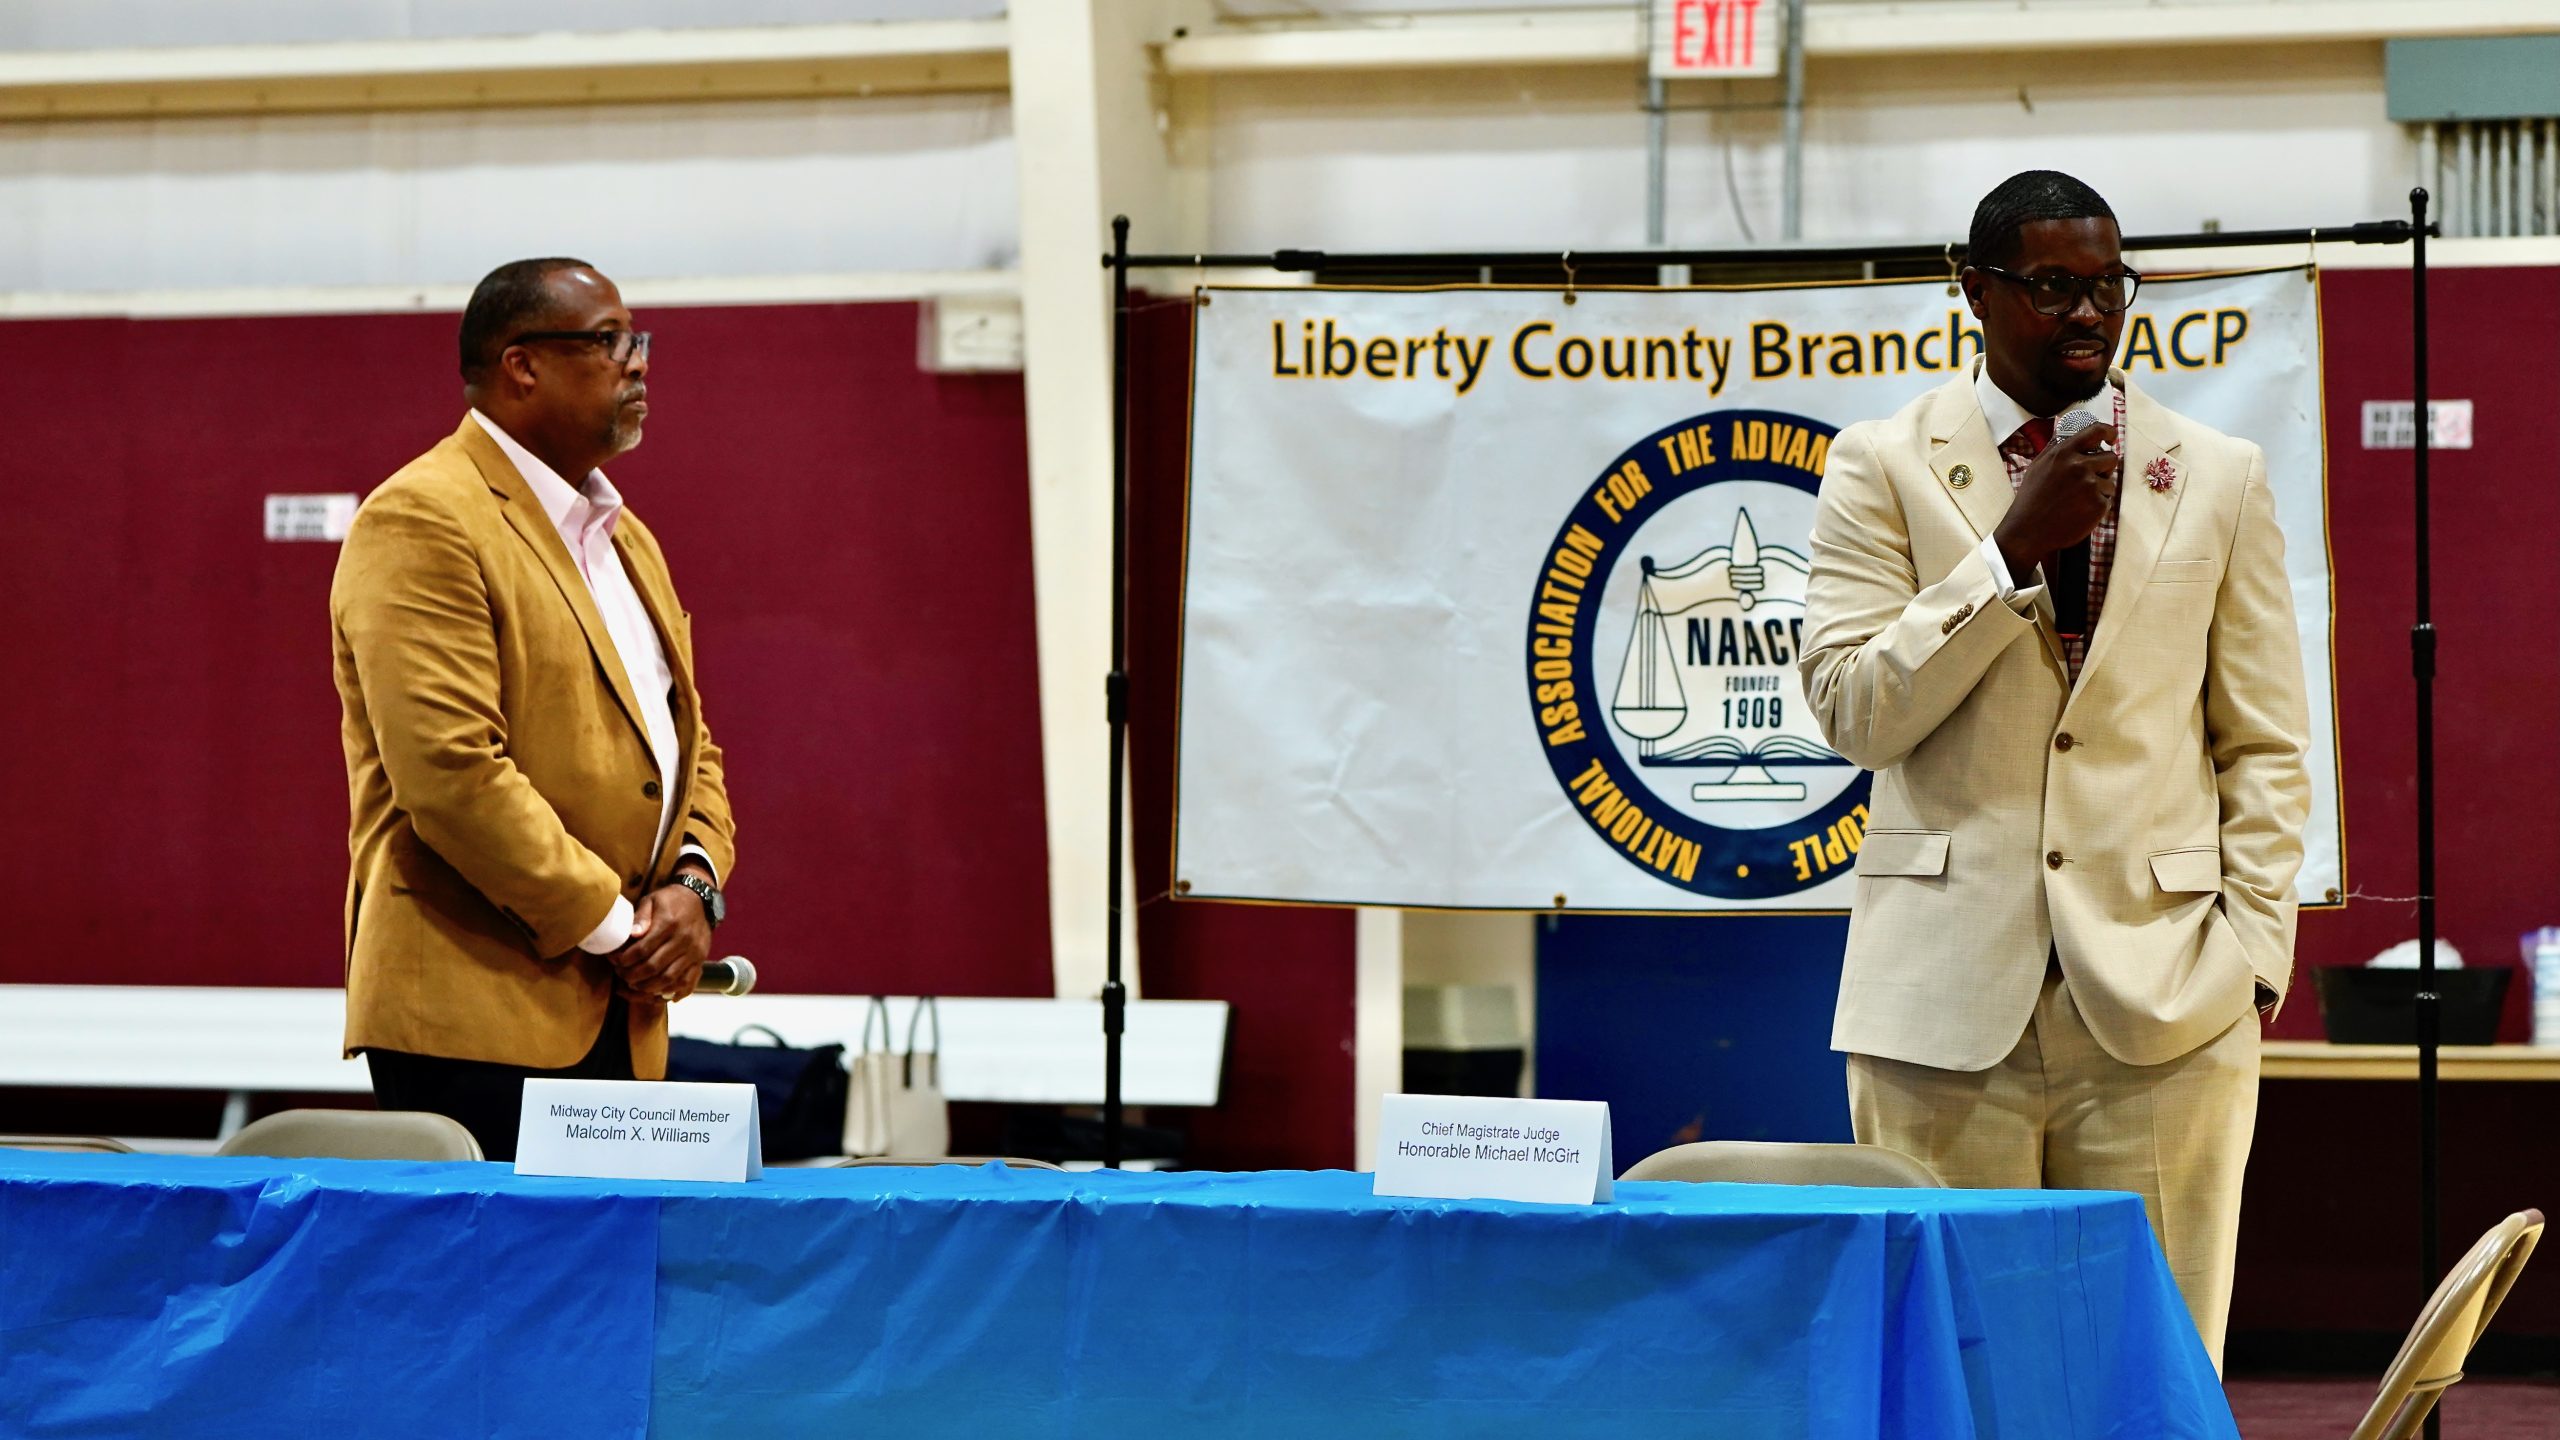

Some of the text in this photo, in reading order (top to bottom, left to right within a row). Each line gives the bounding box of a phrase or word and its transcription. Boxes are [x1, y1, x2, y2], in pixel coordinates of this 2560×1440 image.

[1674, 0, 1761, 68] EXIT
[1273, 306, 2250, 398] Liberty County Branch ACP
[1534, 420, 1833, 883] NATIONAL ASSOCIATION FOR THE ADVAN
[1725, 676, 1780, 692] FOUNDED
[1722, 697, 1782, 729] 1909
[1788, 803, 1870, 882] EOPLE
[550, 1104, 730, 1123] Midway City Council Member
[566, 1124, 710, 1144] Malcolm X. Williams
[1421, 1122, 1560, 1143] Chief Magistrate Judge
[1398, 1141, 1579, 1164] Honorable Michael McGirt
